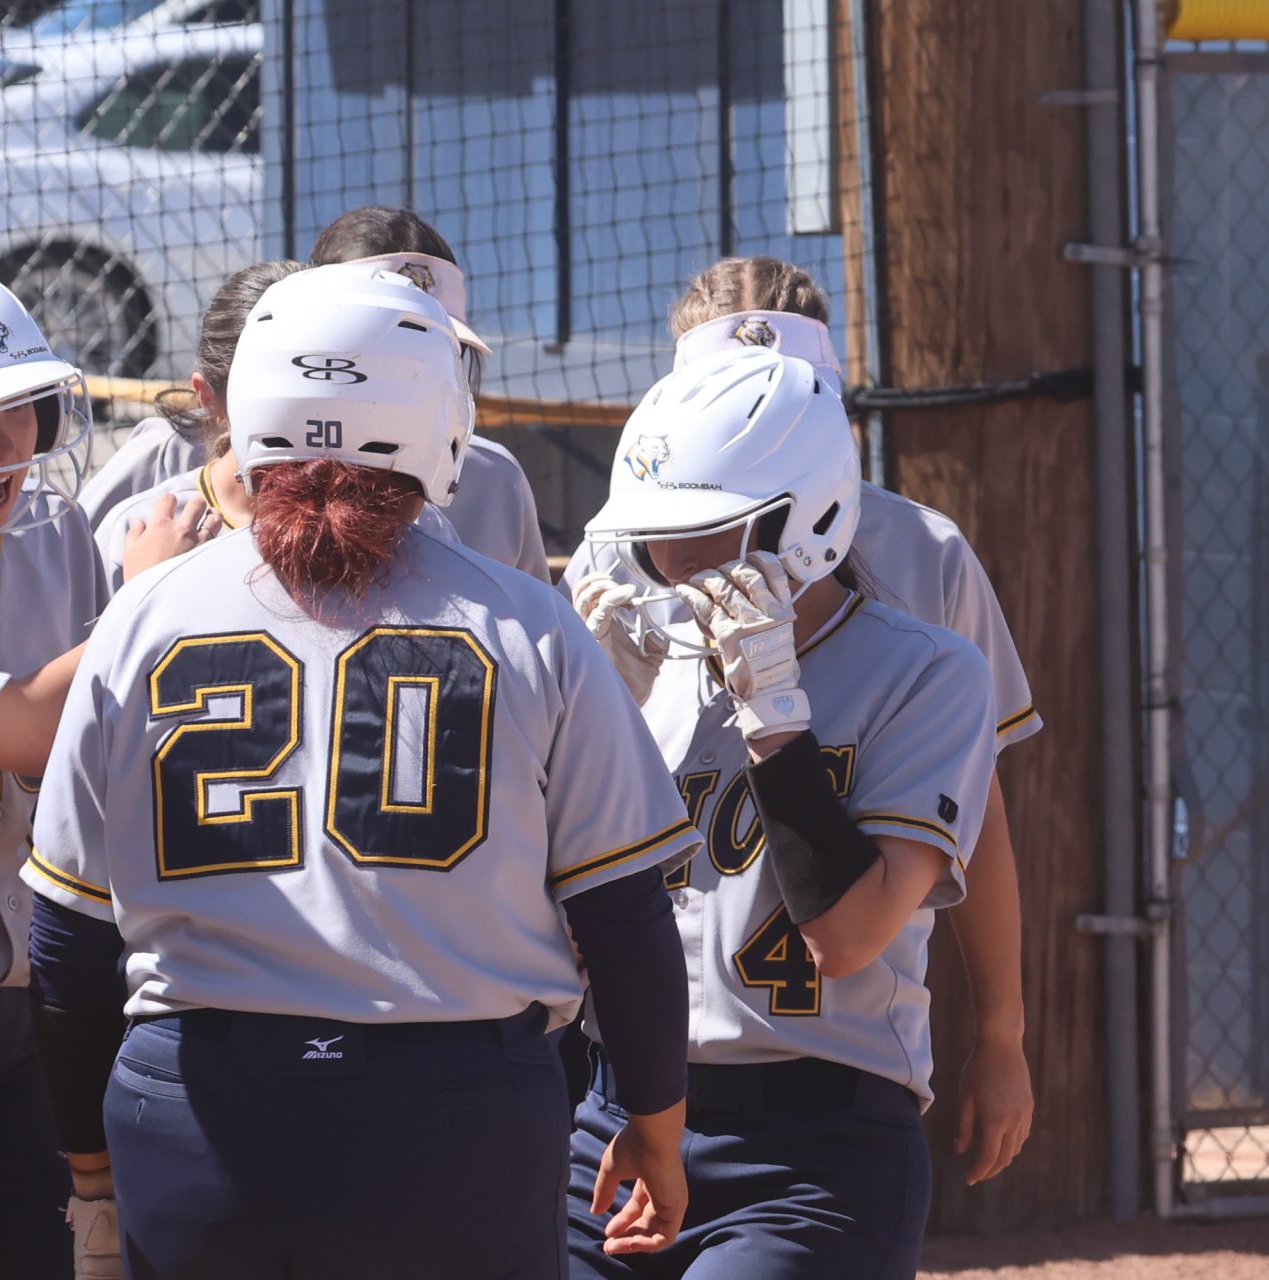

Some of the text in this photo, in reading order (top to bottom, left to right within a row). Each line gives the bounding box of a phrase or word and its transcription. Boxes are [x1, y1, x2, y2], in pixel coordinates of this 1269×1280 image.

[305, 419, 342, 448] 20
[678, 482, 723, 491] BOOMBAH
[146, 624, 499, 882] 20
[733, 903, 821, 1017] 4
